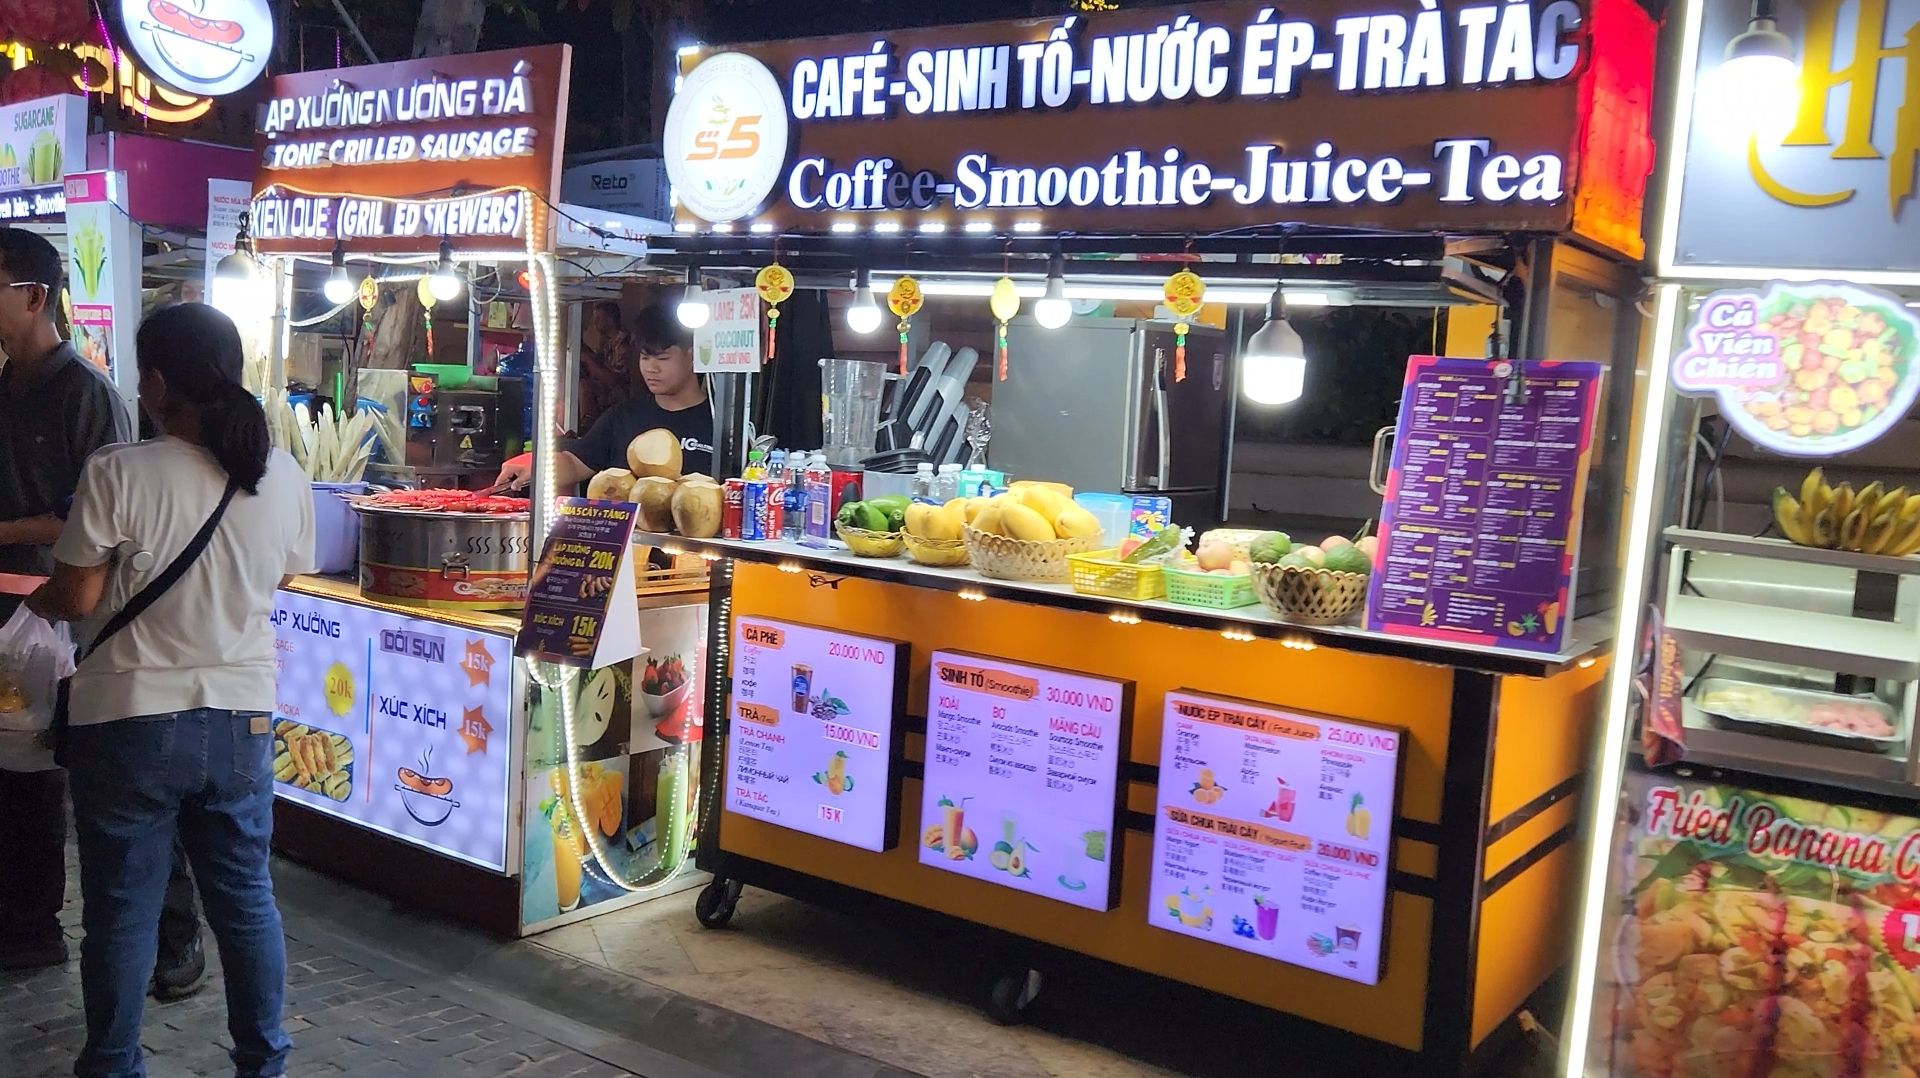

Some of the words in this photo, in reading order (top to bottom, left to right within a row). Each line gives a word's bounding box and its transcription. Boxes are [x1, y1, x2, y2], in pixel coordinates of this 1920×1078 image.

[792, 40, 1010, 120] CAFÉ-SINH
[14, 105, 55, 132] SUGARCANE
[420, 127, 530, 158] SAUSAGE
[1710, 300, 1755, 328] Cá
[714, 329, 755, 348] COCONUT
[292, 611, 341, 639] XƯỞNG
[940, 667, 967, 685] SINH
[379, 695, 408, 720] XÚC
[413, 704, 447, 731] XÍCH
[1650, 789, 1739, 845] Fried
[1747, 804, 1886, 873] Banana
